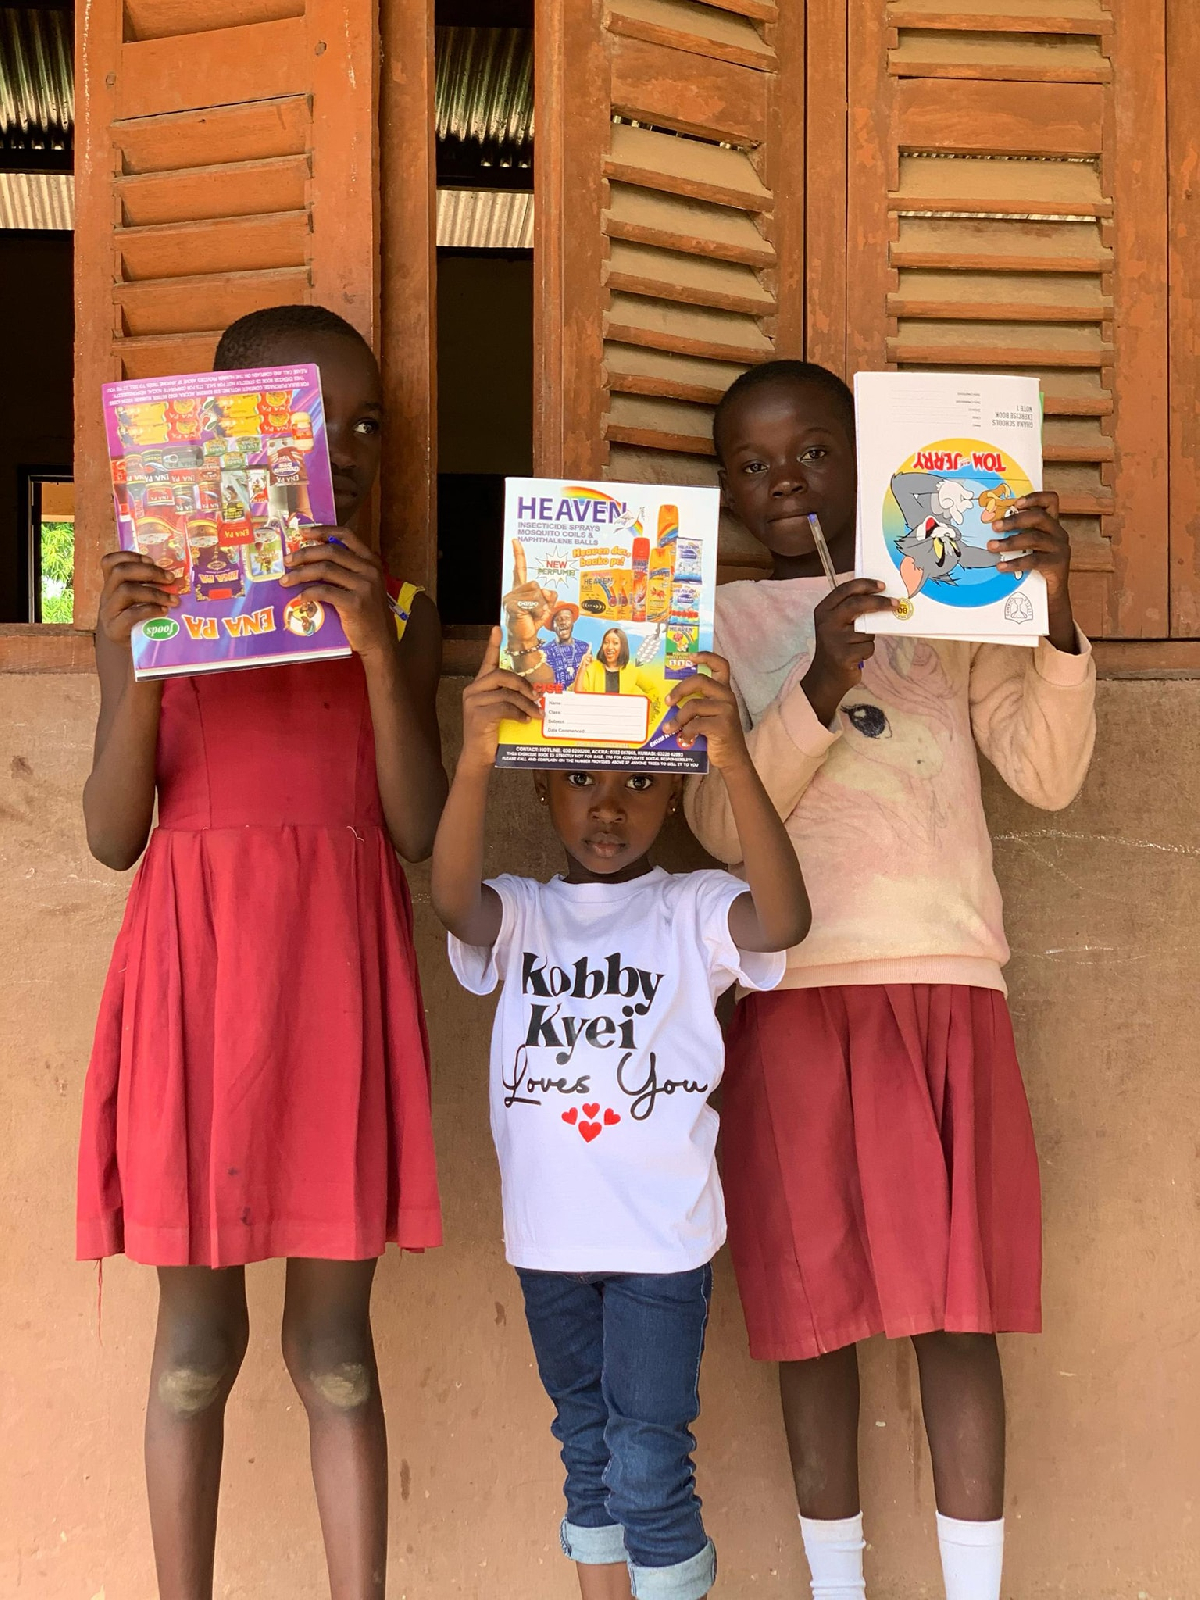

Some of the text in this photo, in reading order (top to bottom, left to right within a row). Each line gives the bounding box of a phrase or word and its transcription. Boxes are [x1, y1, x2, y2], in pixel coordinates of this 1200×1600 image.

[913, 452, 961, 470] JERRY
[972, 452, 1006, 472] TOM
[517, 496, 627, 524] HEAVEN
[569, 524, 600, 532] SPRAYS
[144, 622, 177, 640] foods
[182, 606, 276, 640] ENA PA
[522, 952, 664, 1015] Kobby
[525, 1002, 638, 1065] Kyei
[502, 1044, 708, 1121] Loves You
